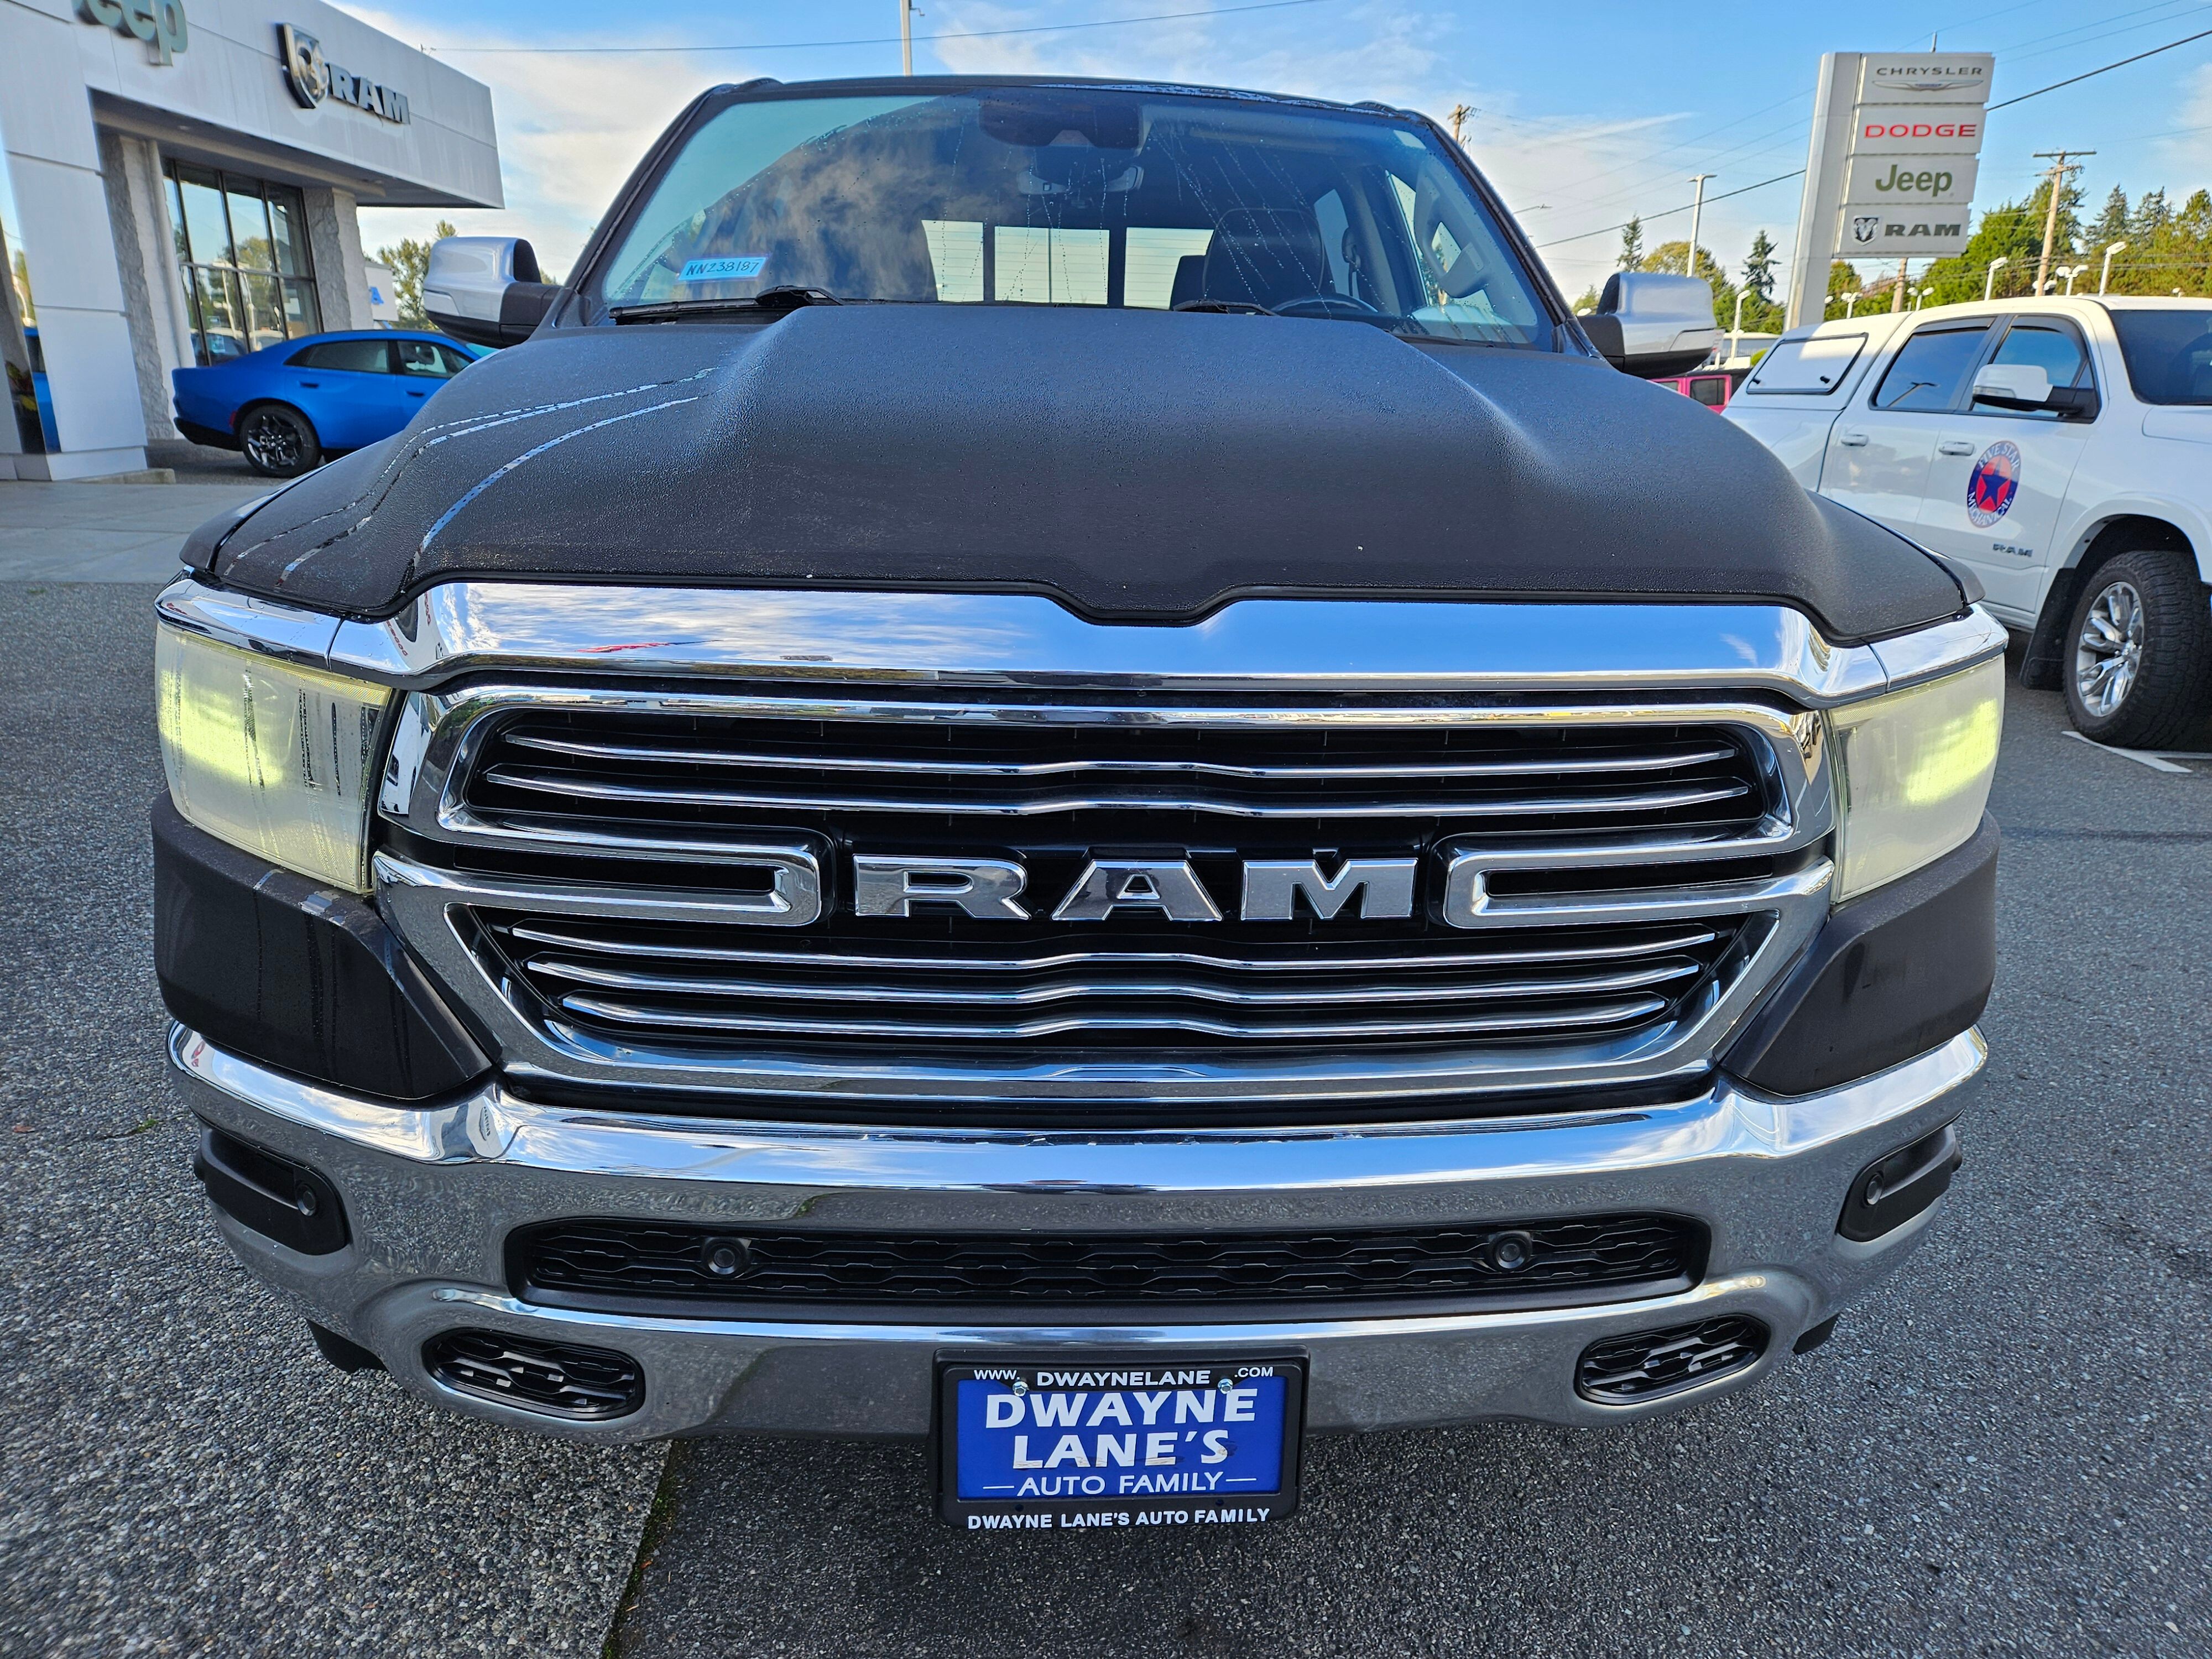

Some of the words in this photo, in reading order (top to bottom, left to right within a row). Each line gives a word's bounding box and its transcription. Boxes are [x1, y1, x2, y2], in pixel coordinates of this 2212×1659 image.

[1876, 67, 1983, 76] CHRYSLER
[325, 62, 410, 125] RAM
[1865, 124, 1977, 138] DODGE
[1875, 164, 1953, 197] Jeep
[1885, 224, 1961, 236] RAM
[686, 261, 760, 276] NN238187
[1978, 443, 2001, 468] FIVE
[2001, 442, 2021, 471] STAR
[1968, 491, 2012, 525] MECHANICAL
[1993, 543, 2033, 557] RAM
[853, 854, 1418, 921] RAM
[1037, 1370, 1211, 1386] DWAYNELANE
[1234, 1367, 1274, 1378] .COM
[985, 1389, 1258, 1428] DWAYNE
[1013, 1430, 1229, 1469] LANE'S
[1017, 1475, 1105, 1496] AUTO
[1119, 1472, 1224, 1494] FAMILY
[968, 1515, 1052, 1529] DWAYNE
[1061, 1512, 1130, 1527] LANE'S
[1135, 1510, 1188, 1525] AUTO
[1194, 1508, 1270, 1523] FAMILY
